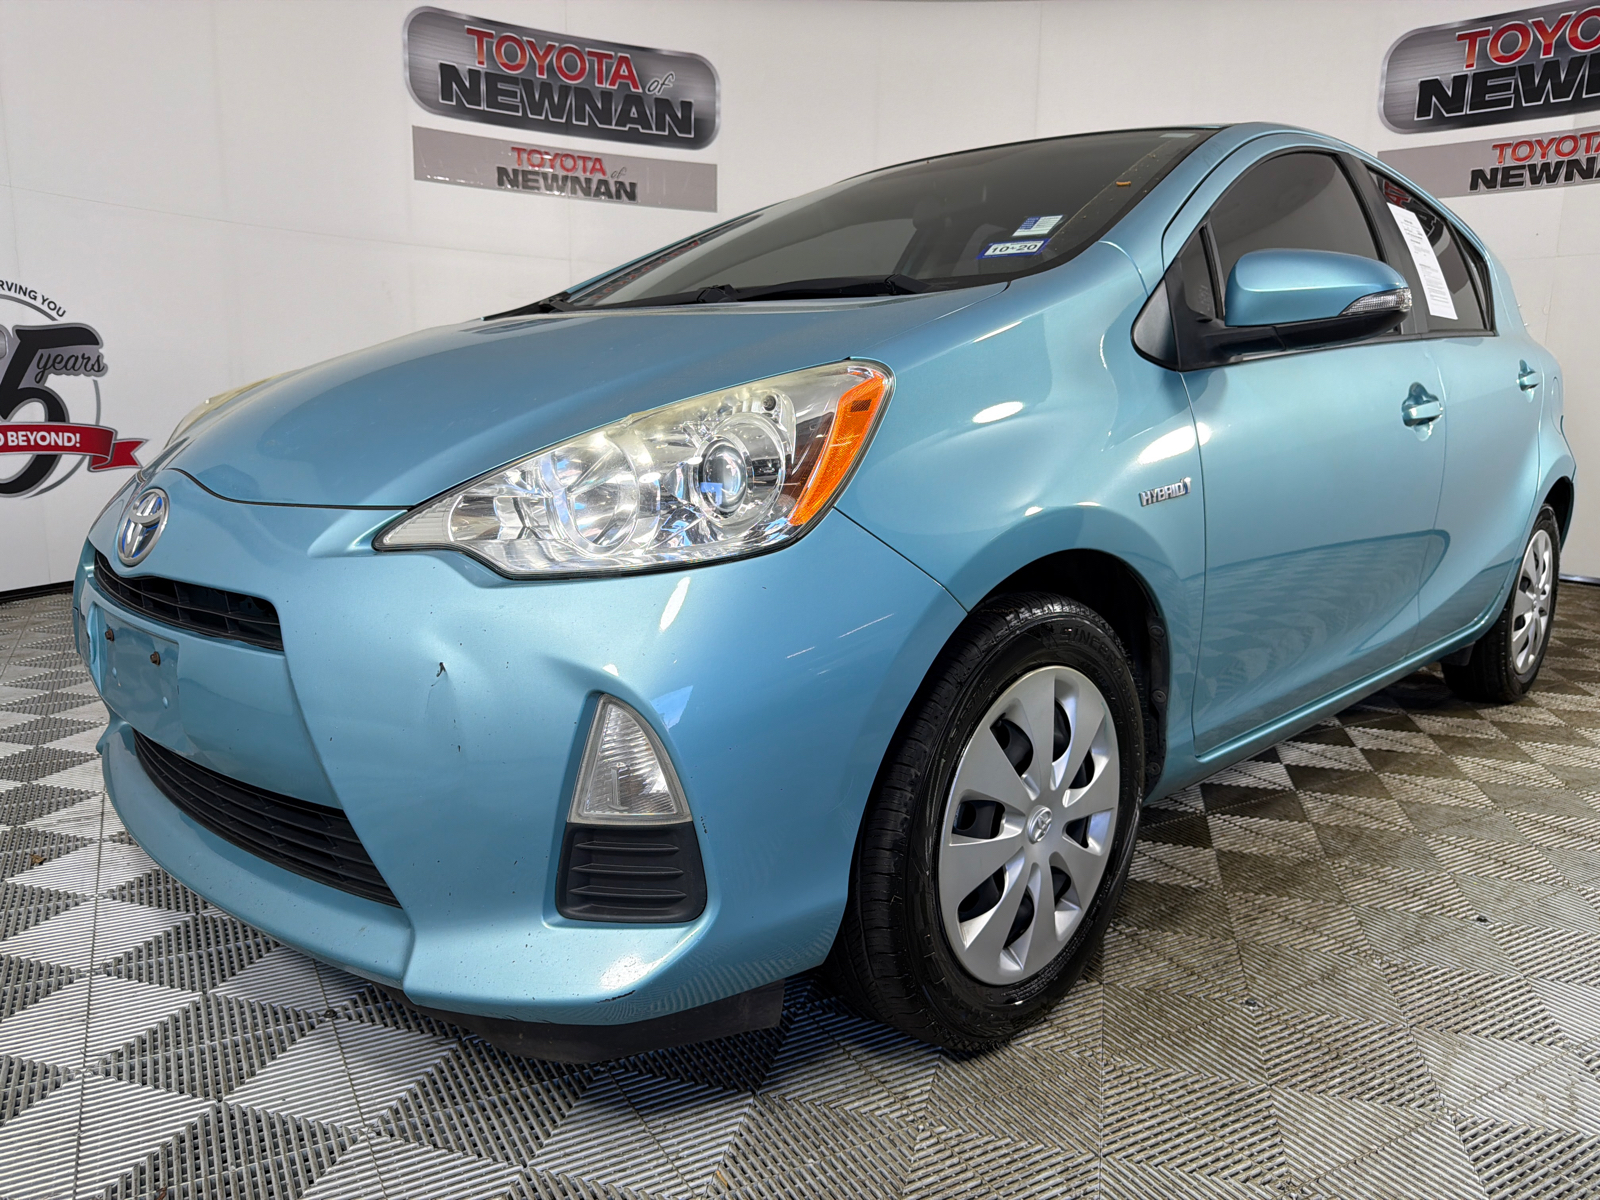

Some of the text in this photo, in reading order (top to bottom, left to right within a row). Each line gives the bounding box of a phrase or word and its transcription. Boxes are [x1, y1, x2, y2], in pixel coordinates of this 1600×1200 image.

[466, 26, 675, 95] TOYOTA of
[438, 62, 695, 138] NEWNAN
[511, 146, 628, 179] TOYOTA of
[496, 166, 637, 201] NEWNAN
[41, 294, 67, 318] YOU
[34, 352, 106, 384] years
[7, 431, 81, 448] BEYOND!
[1139, 480, 1187, 507] HYBRID
